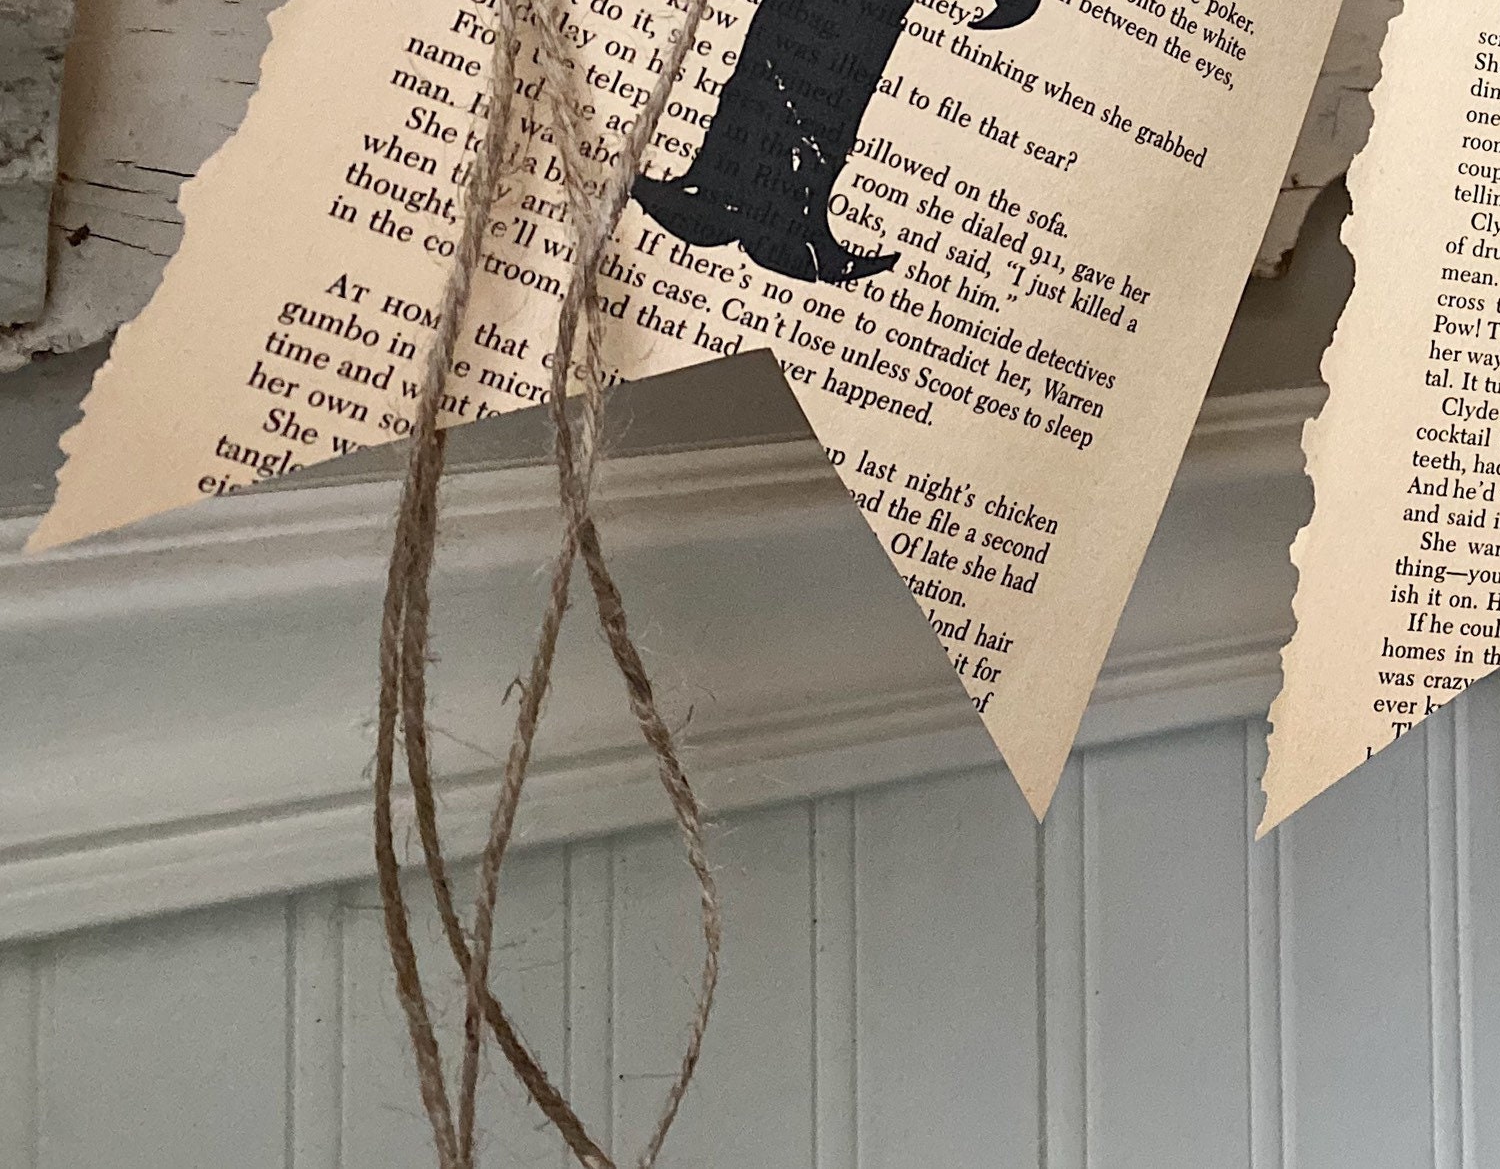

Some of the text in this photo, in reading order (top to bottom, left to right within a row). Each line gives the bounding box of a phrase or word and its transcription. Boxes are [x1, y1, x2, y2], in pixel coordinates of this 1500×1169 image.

[908, 87, 1078, 172] to file that sear?
[827, 193, 1137, 333] Oaks, and said, "I just killed a
[851, 171, 1150, 305] room she dialed 911, gave her
[278, 302, 416, 361] gumbo in
[324, 273, 529, 359] AT HOM that
[246, 361, 368, 422] her own
[266, 332, 394, 390] time and
[856, 449, 1058, 535] last night's chicken
[1420, 531, 1456, 553] She
